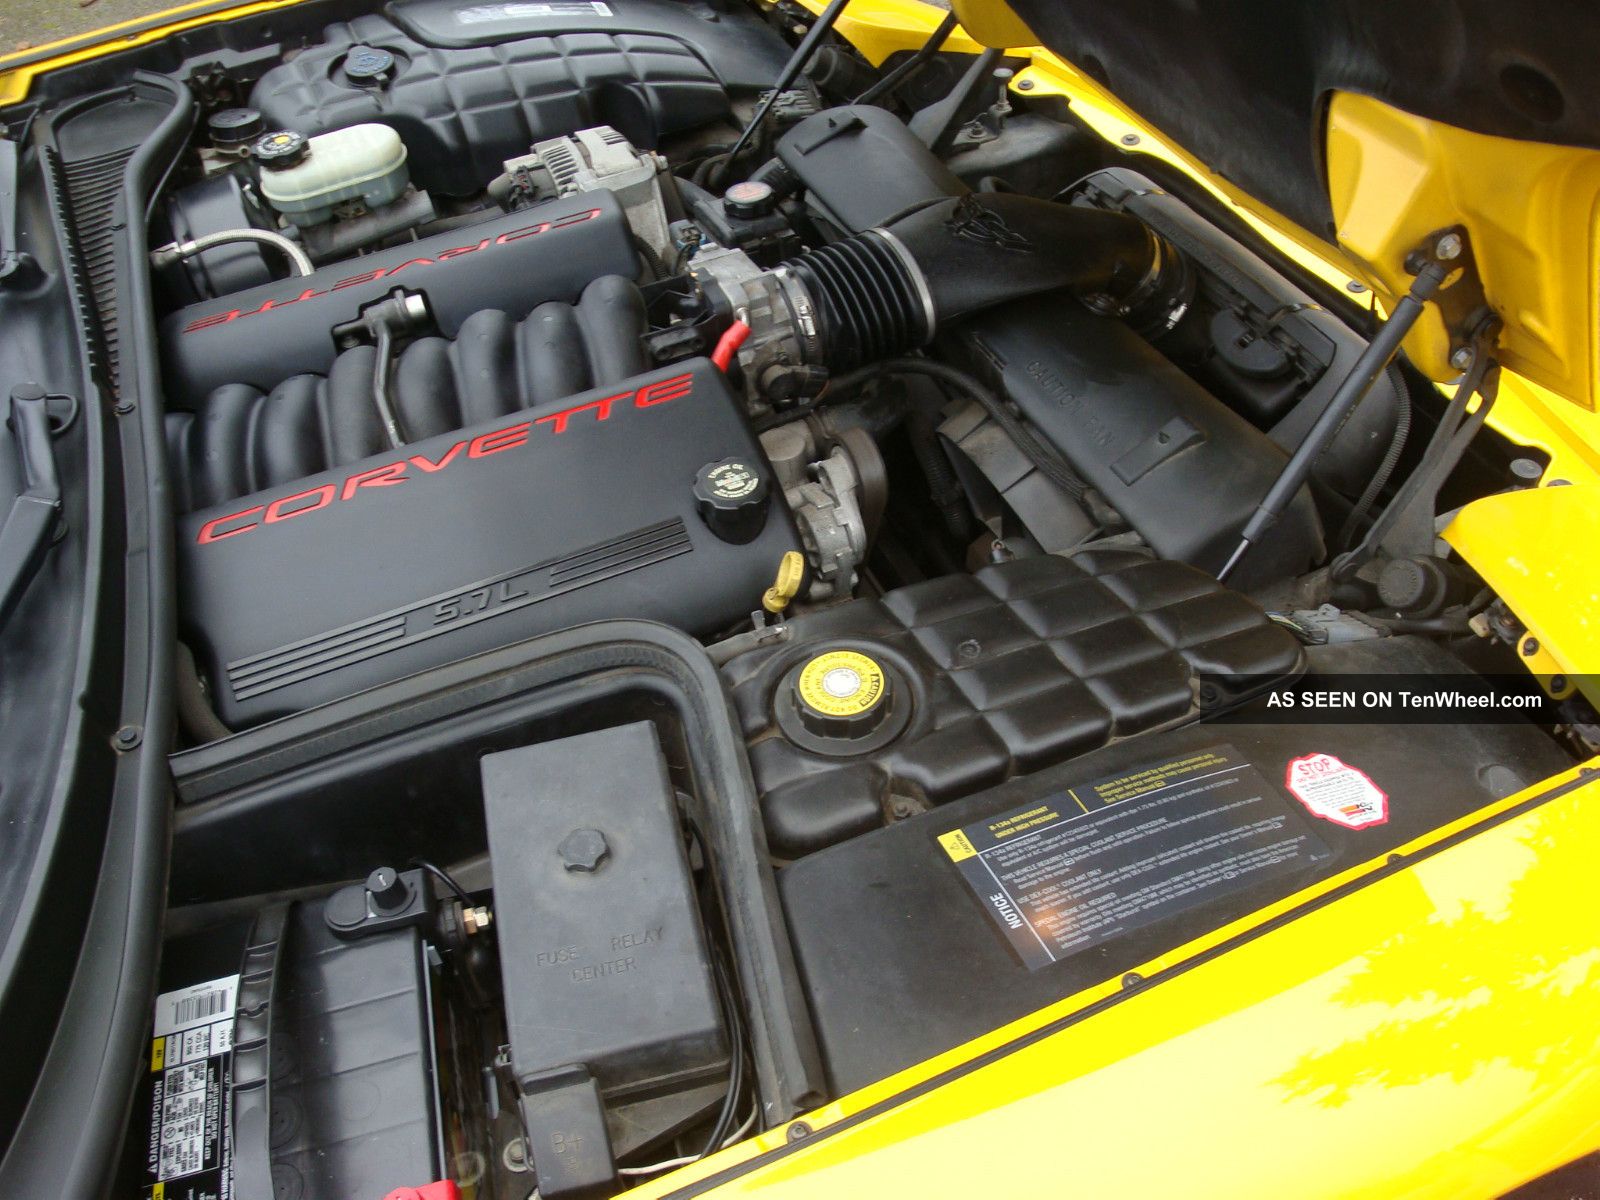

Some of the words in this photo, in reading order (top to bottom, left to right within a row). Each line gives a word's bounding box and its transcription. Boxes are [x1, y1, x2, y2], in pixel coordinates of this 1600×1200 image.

[183, 208, 603, 334] CORVETTE
[197, 373, 694, 544] CORVETTE
[433, 582, 530, 625] 5.7L
[1298, 758, 1330, 775] STOP
[989, 892, 1023, 929] NOTICE
[536, 945, 580, 967] FUSE
[610, 926, 664, 952] RELAY
[572, 957, 638, 982] CENTER
[149, 1081, 163, 1163] DANGER/POISON
